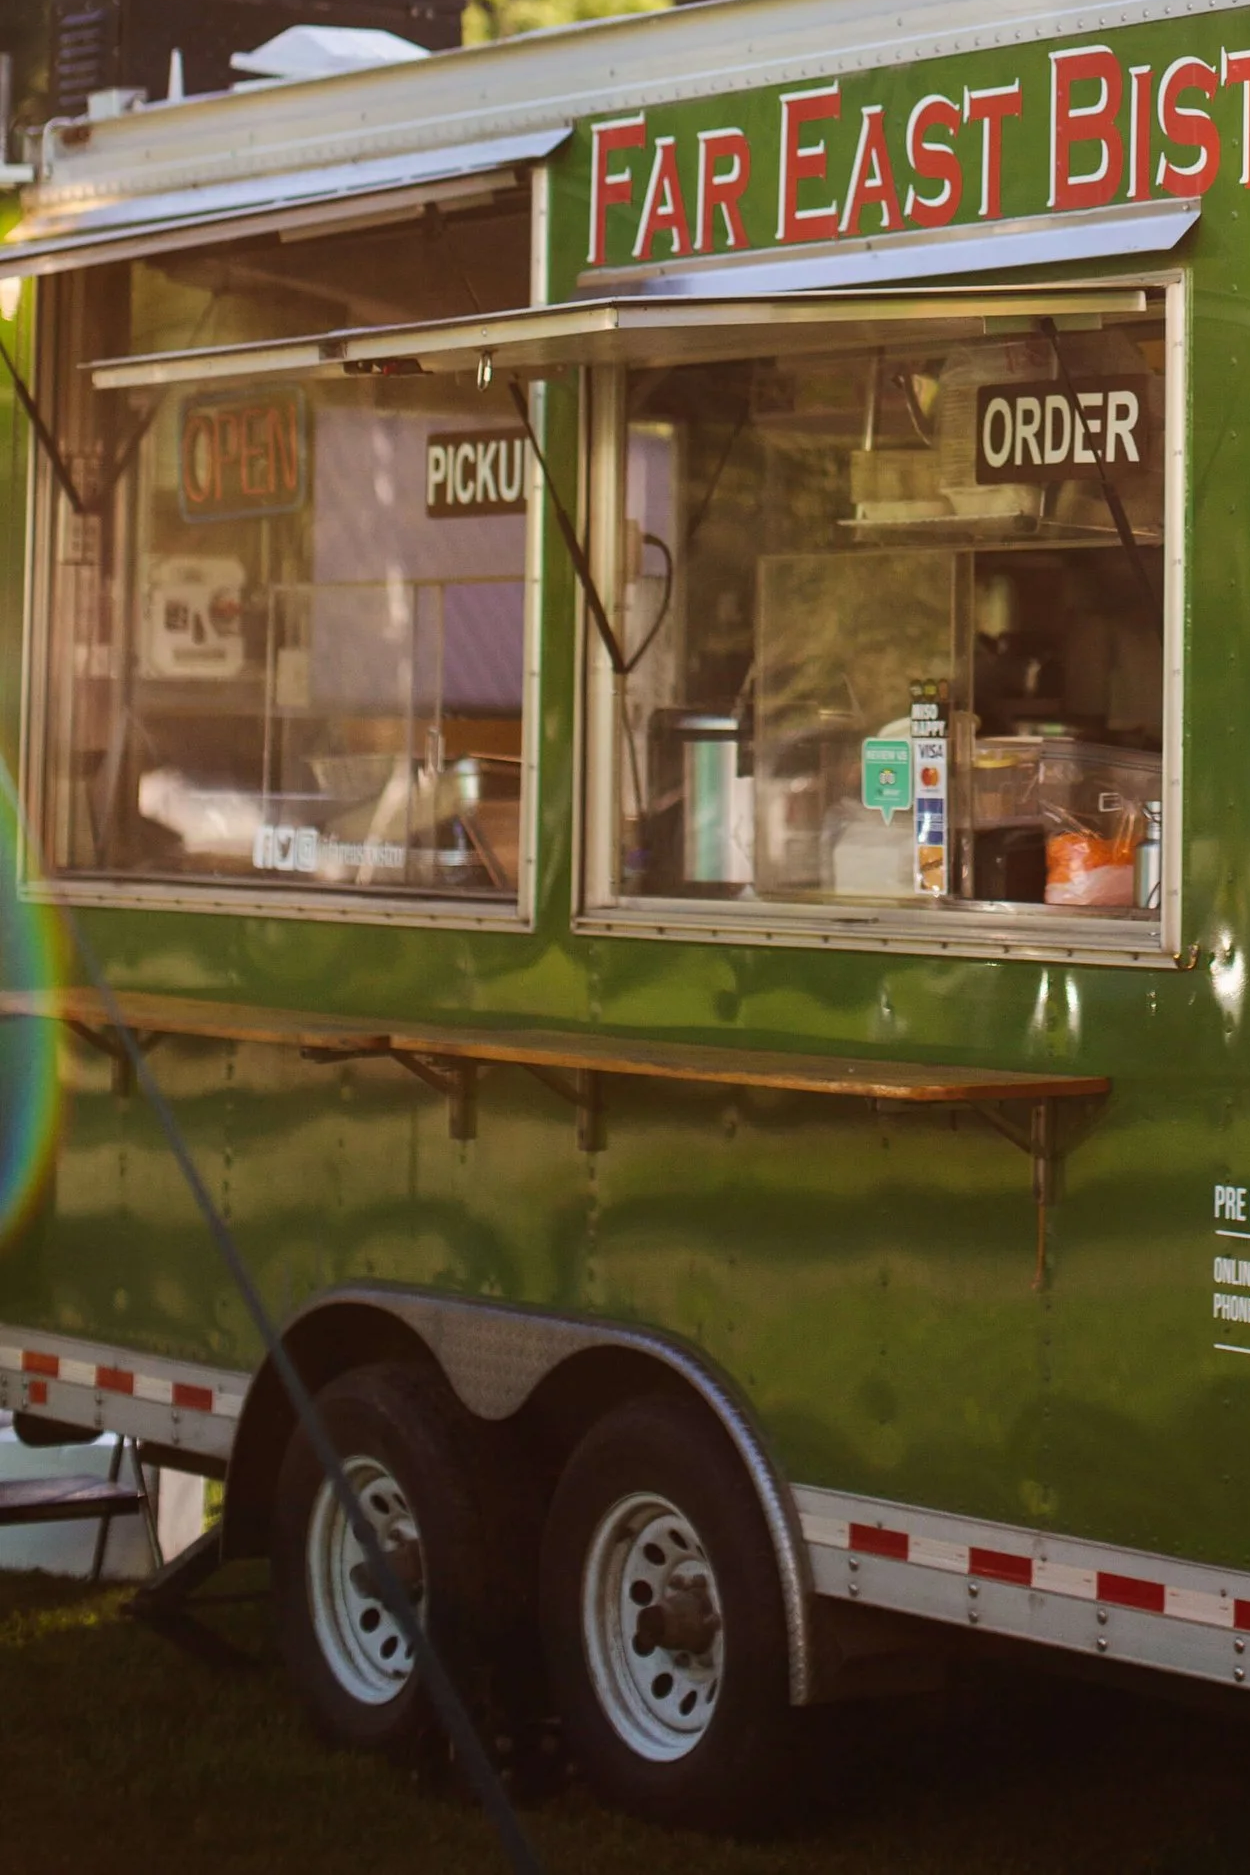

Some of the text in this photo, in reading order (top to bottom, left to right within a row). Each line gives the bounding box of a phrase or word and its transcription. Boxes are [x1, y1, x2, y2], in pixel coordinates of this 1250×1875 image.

[586, 111, 751, 266] FAR
[775, 78, 1022, 244] EAST
[182, 403, 298, 503] OPEN
[982, 390, 1140, 468] ORDER
[918, 743, 944, 759] VISA
[1214, 1185, 1247, 1221] PRE
